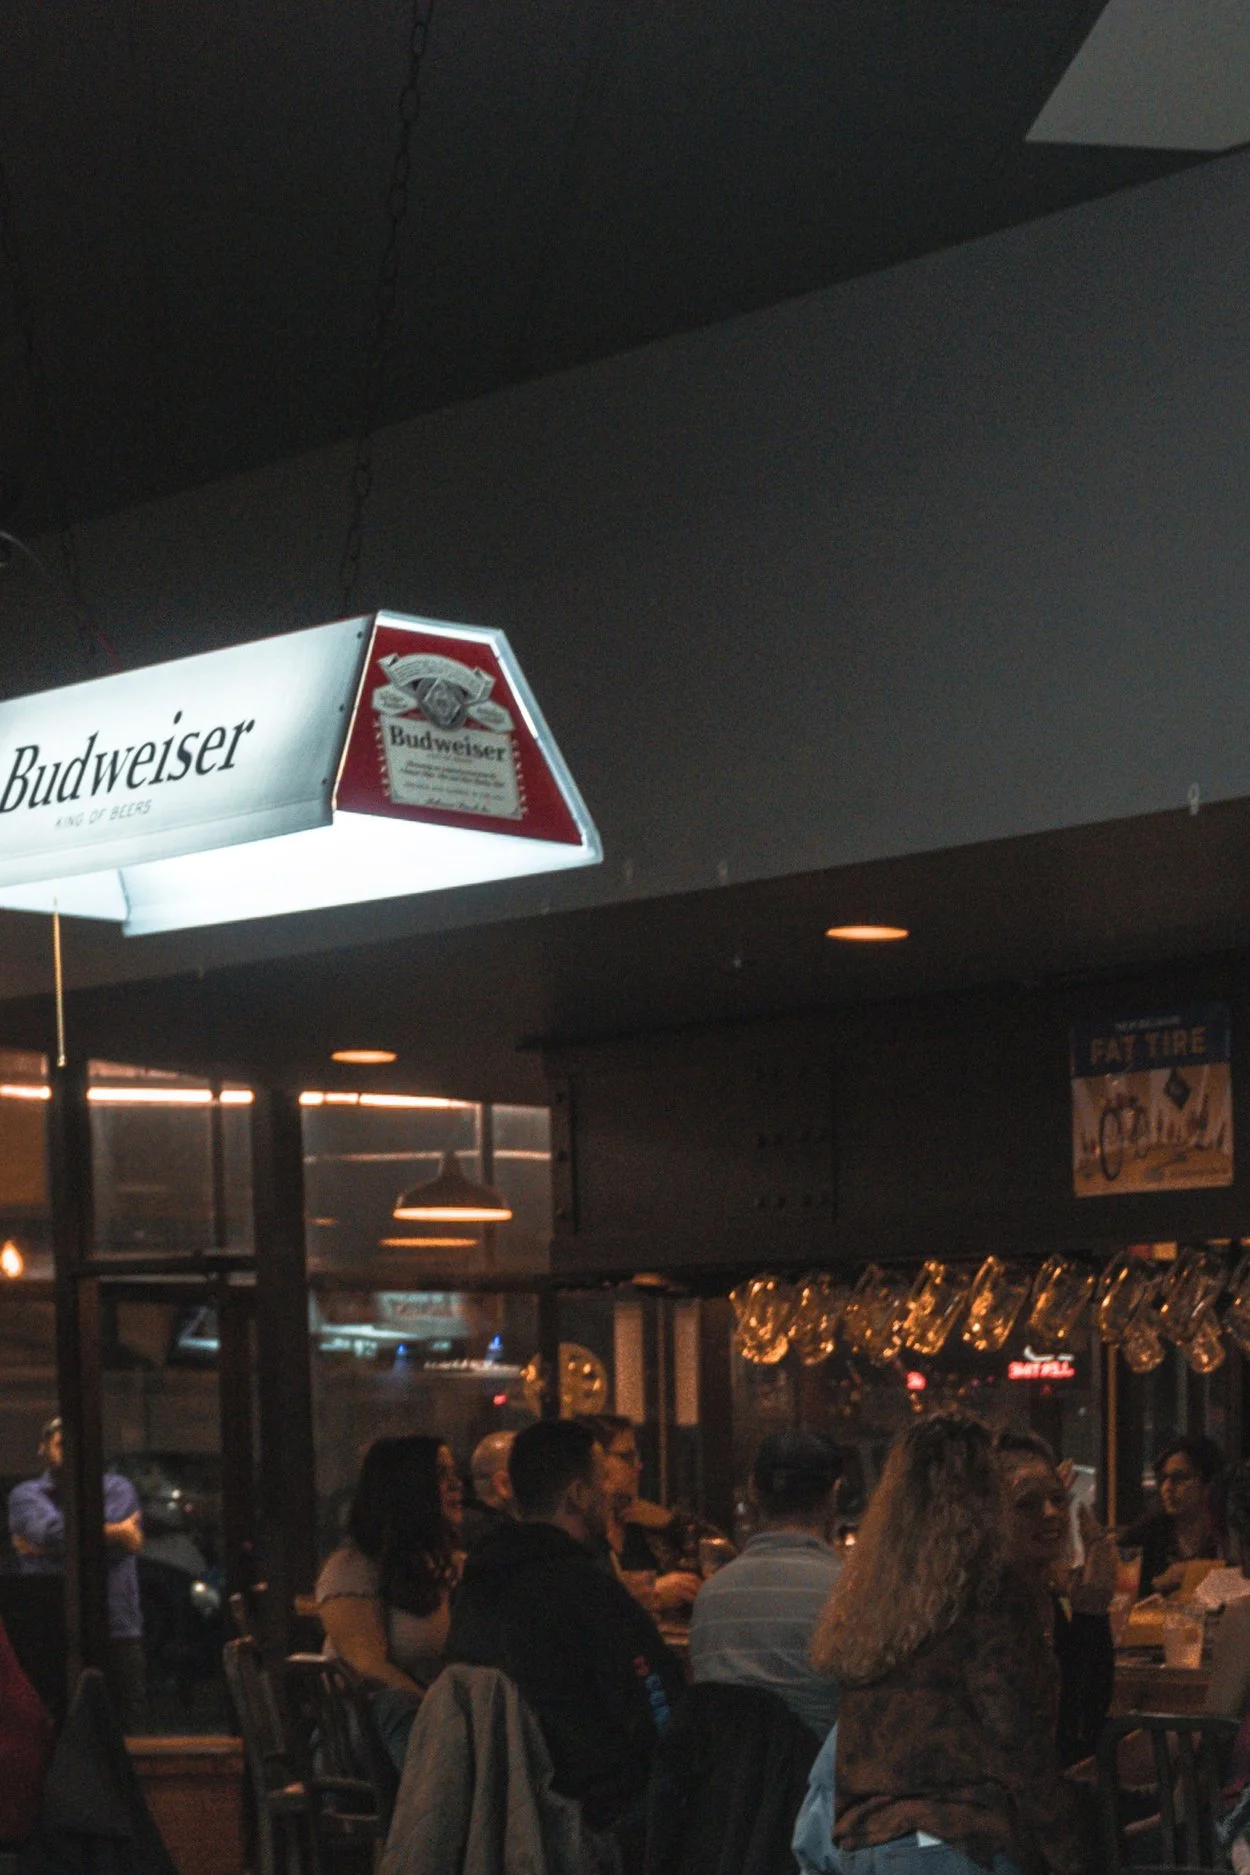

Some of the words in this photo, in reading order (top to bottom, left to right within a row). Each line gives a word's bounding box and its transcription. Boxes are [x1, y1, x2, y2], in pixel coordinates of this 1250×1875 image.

[389, 724, 507, 761] Budweiser
[0, 710, 256, 815] Budweiser
[54, 813, 85, 830] KING
[88, 807, 107, 825] OF
[109, 800, 153, 822] BEERS
[1090, 1032, 1137, 1066] FAT
[1144, 1025, 1208, 1059] TIRE
